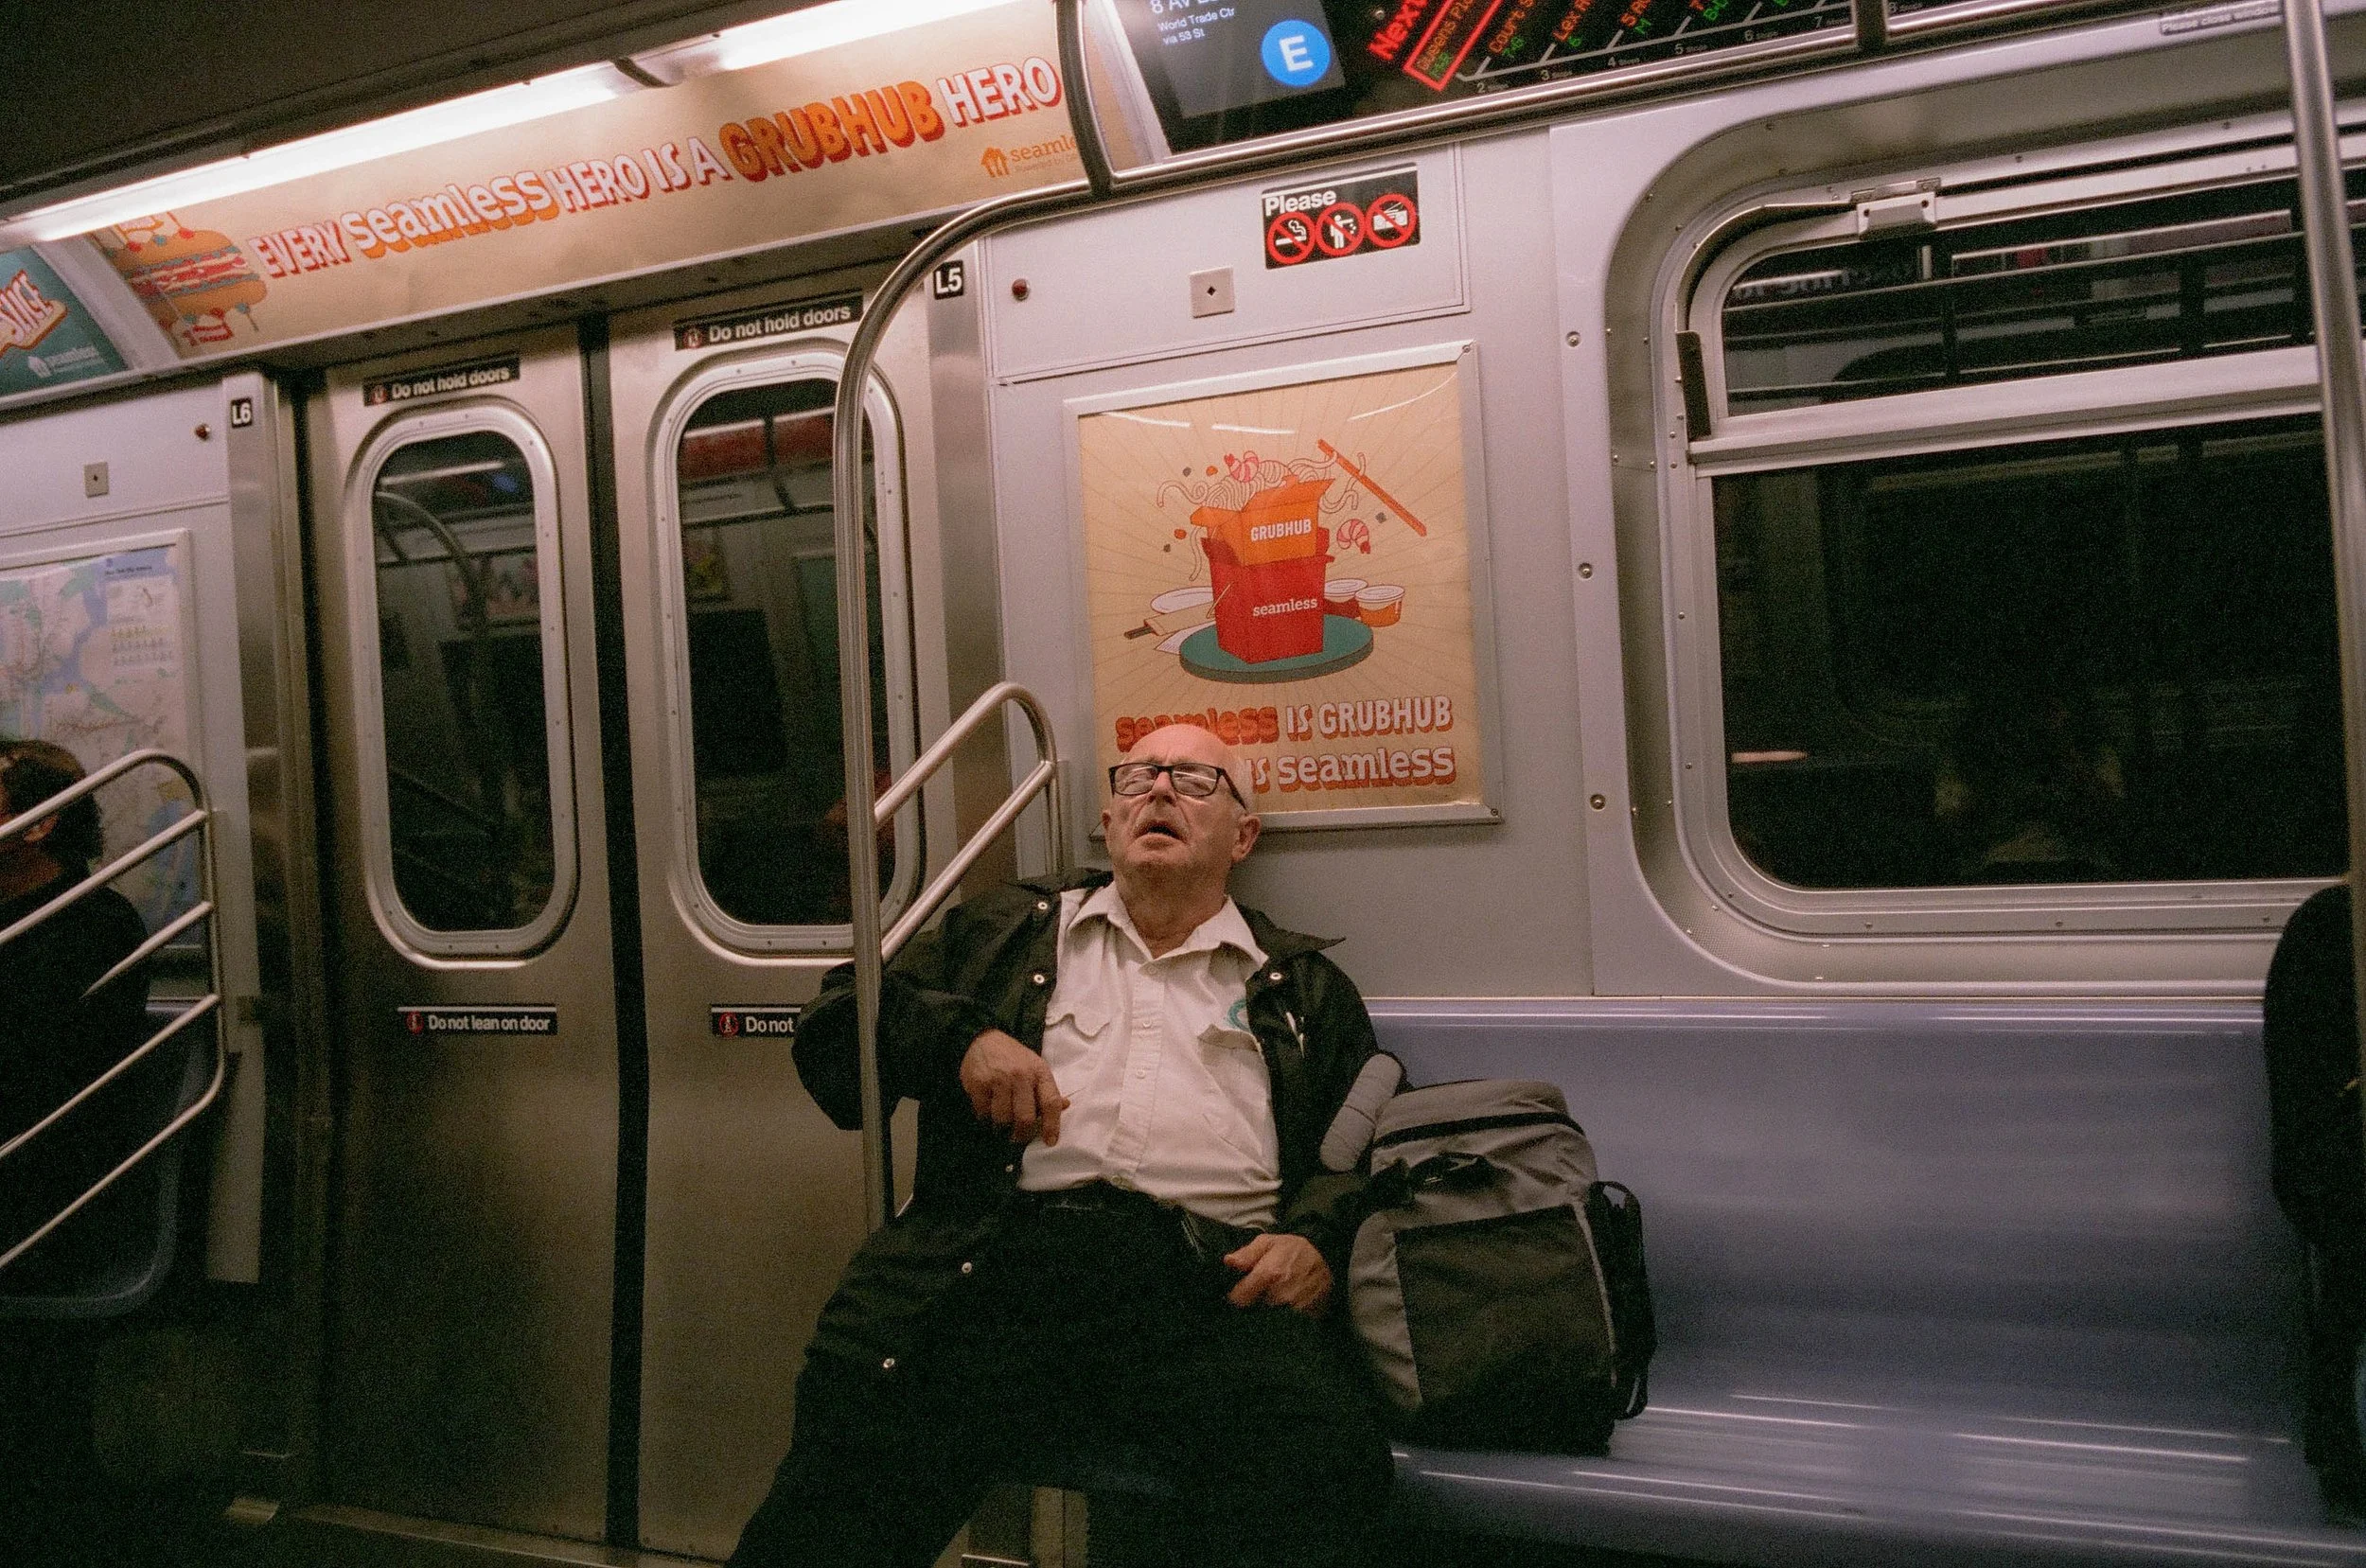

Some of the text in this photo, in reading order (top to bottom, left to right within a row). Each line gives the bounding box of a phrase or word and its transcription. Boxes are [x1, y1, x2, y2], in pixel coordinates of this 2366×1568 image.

[1150, 0, 1163, 13] 8
[1157, 8, 1235, 31] World Trade Ctr
[1552, 10, 1581, 42] Lex
[1633, 17, 1651, 35] M
[1814, 16, 1823, 28] 7
[1163, 27, 1205, 45] via 53 St
[1488, 10, 1526, 54] Court
[1744, 29, 1754, 41] 6
[1279, 34, 1315, 72] E
[1675, 44, 1684, 55] 5
[1608, 57, 1616, 67] 4
[1541, 69, 1550, 80] 3
[1476, 81, 1485, 94] 2
[248, 56, 1062, 278] EVERY seamless HERO IS A GRUBHUB HERO
[1265, 190, 1337, 217] Please
[935, 267, 962, 294] L5
[710, 305, 851, 343] Do not hold doors
[392, 365, 510, 399] Do not hold doors
[231, 402, 251, 426] L6
[1250, 519, 1312, 542] GRUBHUB
[1252, 598, 1318, 617] seamless
[1286, 703, 1314, 742] IS
[1318, 696, 1454, 740] GRUBHUB
[1245, 747, 1457, 794] IS seamless
[428, 1014, 551, 1031] Do not lean on door
[745, 1015, 794, 1032] Do not
